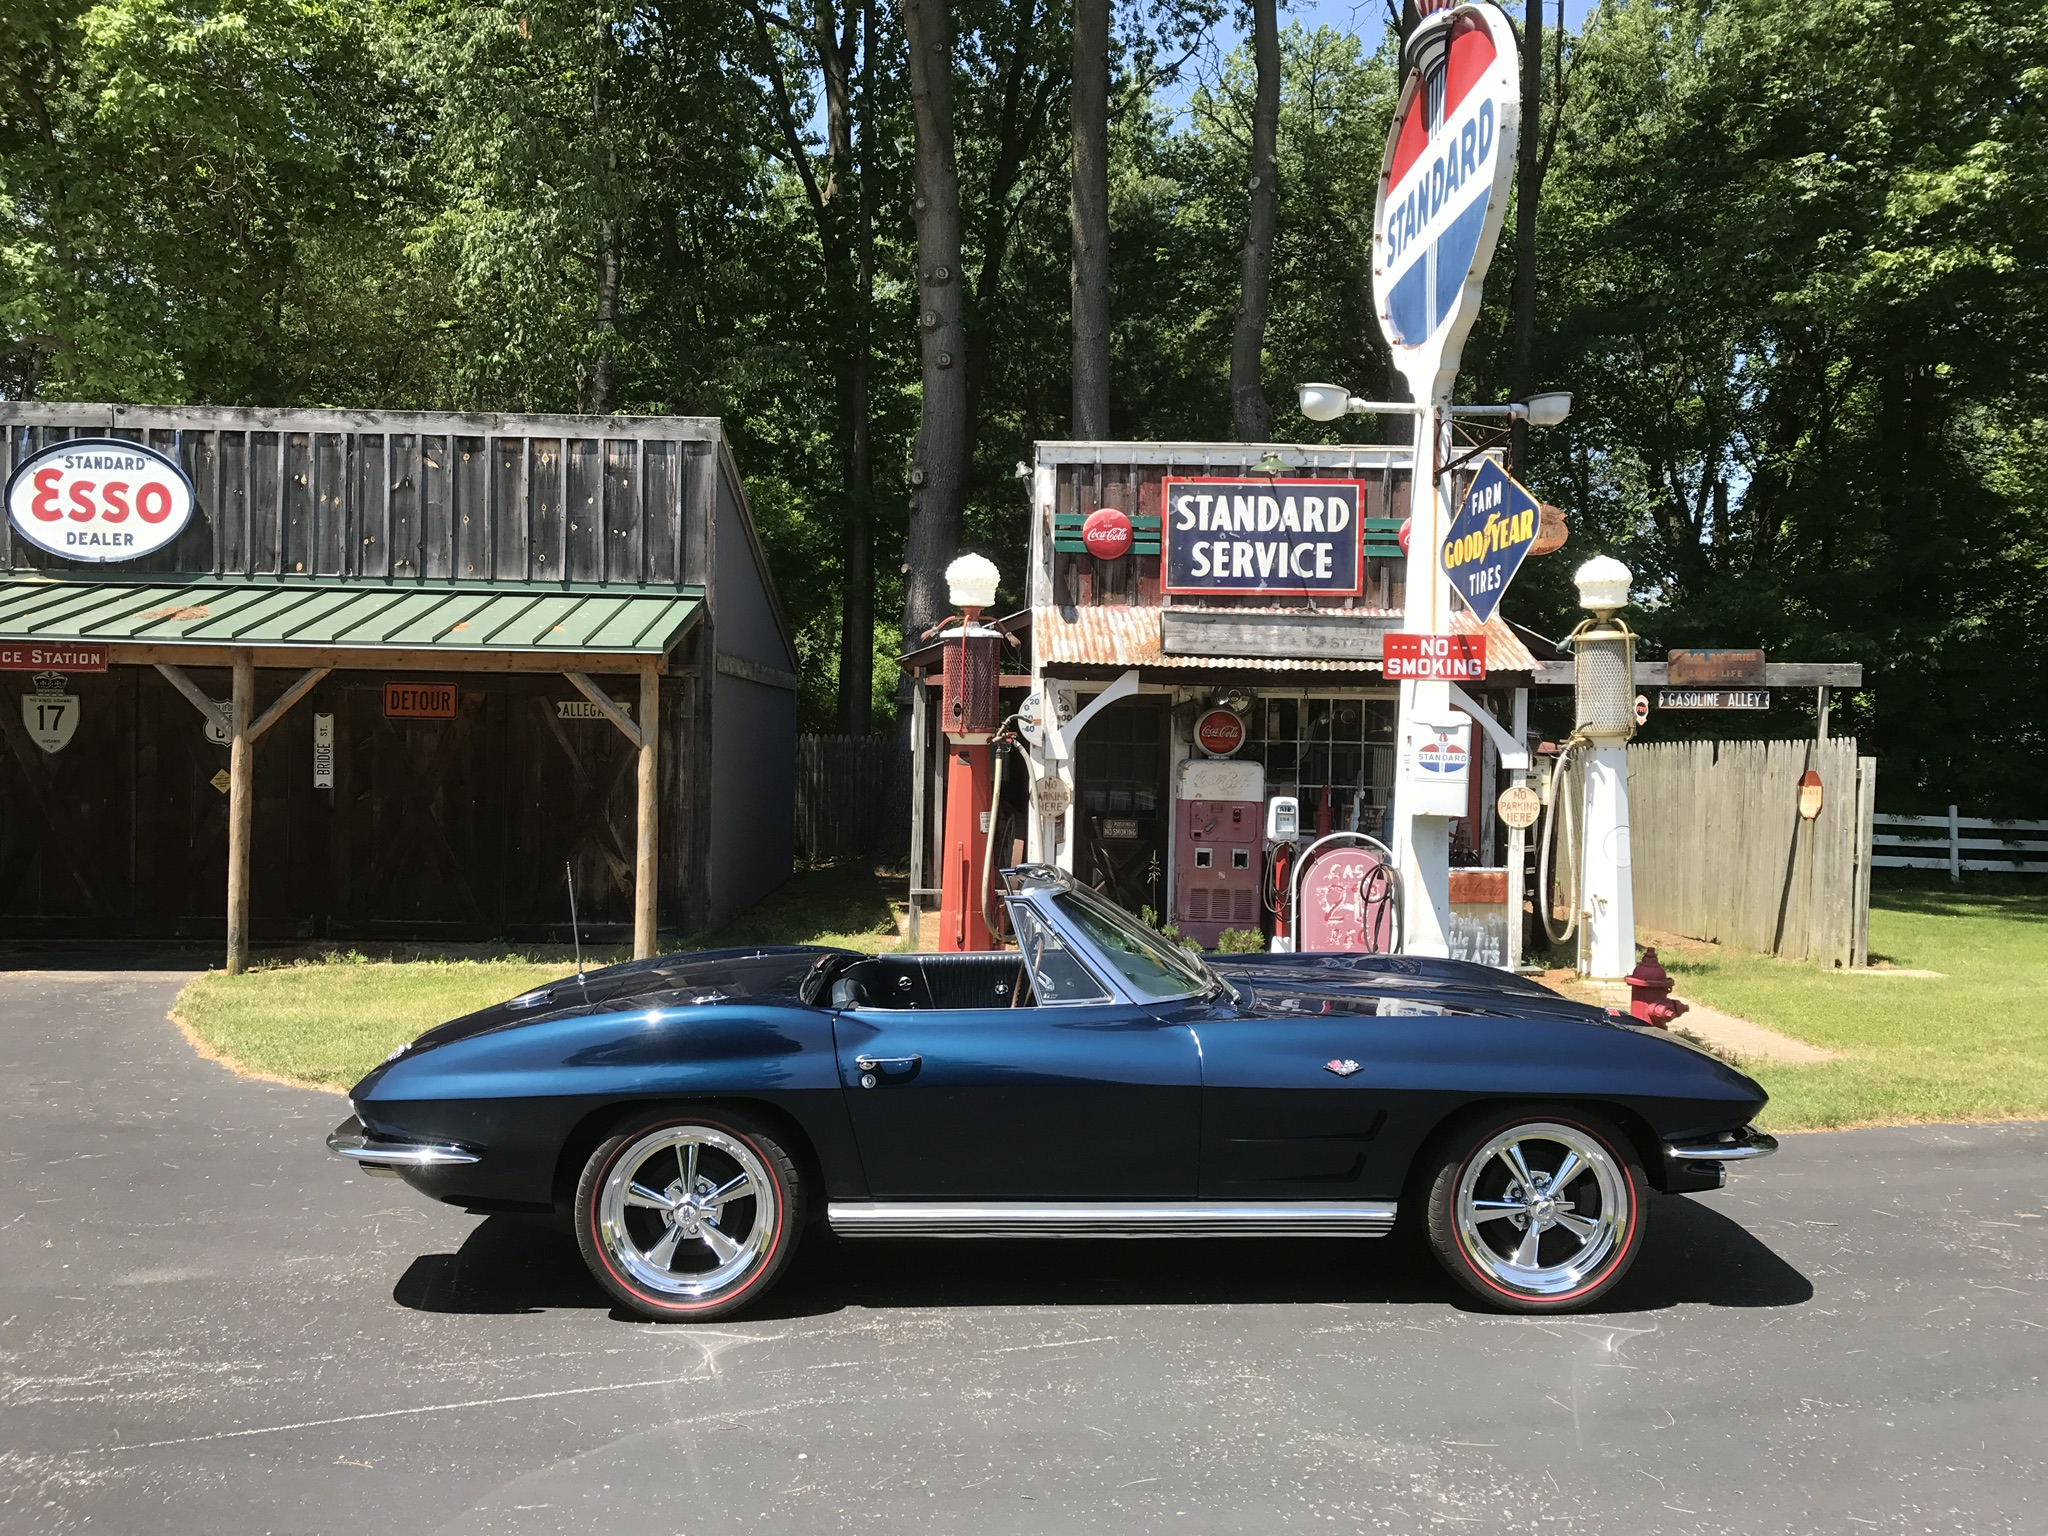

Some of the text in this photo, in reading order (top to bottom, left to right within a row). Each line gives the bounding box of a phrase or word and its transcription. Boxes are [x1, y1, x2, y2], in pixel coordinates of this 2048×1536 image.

[1387, 97, 1494, 268] STANDARD
[1471, 481, 1502, 516] FARM
[1176, 494, 1350, 533] STANDARD
[66, 532, 134, 546] DEALER
[1087, 527, 1129, 541] Coca-Cola
[1444, 509, 1534, 569] GOODYEAR
[1191, 541, 1333, 579] SERVICE
[1469, 564, 1501, 596] TIRES
[1420, 639, 1449, 656] NO
[31, 649, 100, 665] STATION
[1387, 657, 1482, 675] SMOKING
[1721, 669, 1743, 678] LIFE
[391, 690, 450, 711] DETOUR
[1668, 692, 1762, 707] GASOLINE ALLEY
[562, 703, 606, 718] ALLEGA
[1059, 704, 1070, 712] 80
[37, 705, 65, 731] 17
[1021, 725, 1035, 733] -40
[1201, 725, 1239, 738] Coca-Cola
[316, 726, 331, 775] BRIDGE ST.
[1418, 753, 1467, 762] STANDARD
[1044, 780, 1057, 789] NO
[1038, 791, 1069, 801] ARKING
[1513, 790, 1527, 800] NO
[1500, 802, 1538, 812] PARKING
[1506, 812, 1532, 823] HERE
[1104, 828, 1136, 836] NO SMOKING
[1449, 930, 1470, 947] We
[1451, 948, 1501, 965] FLATS
